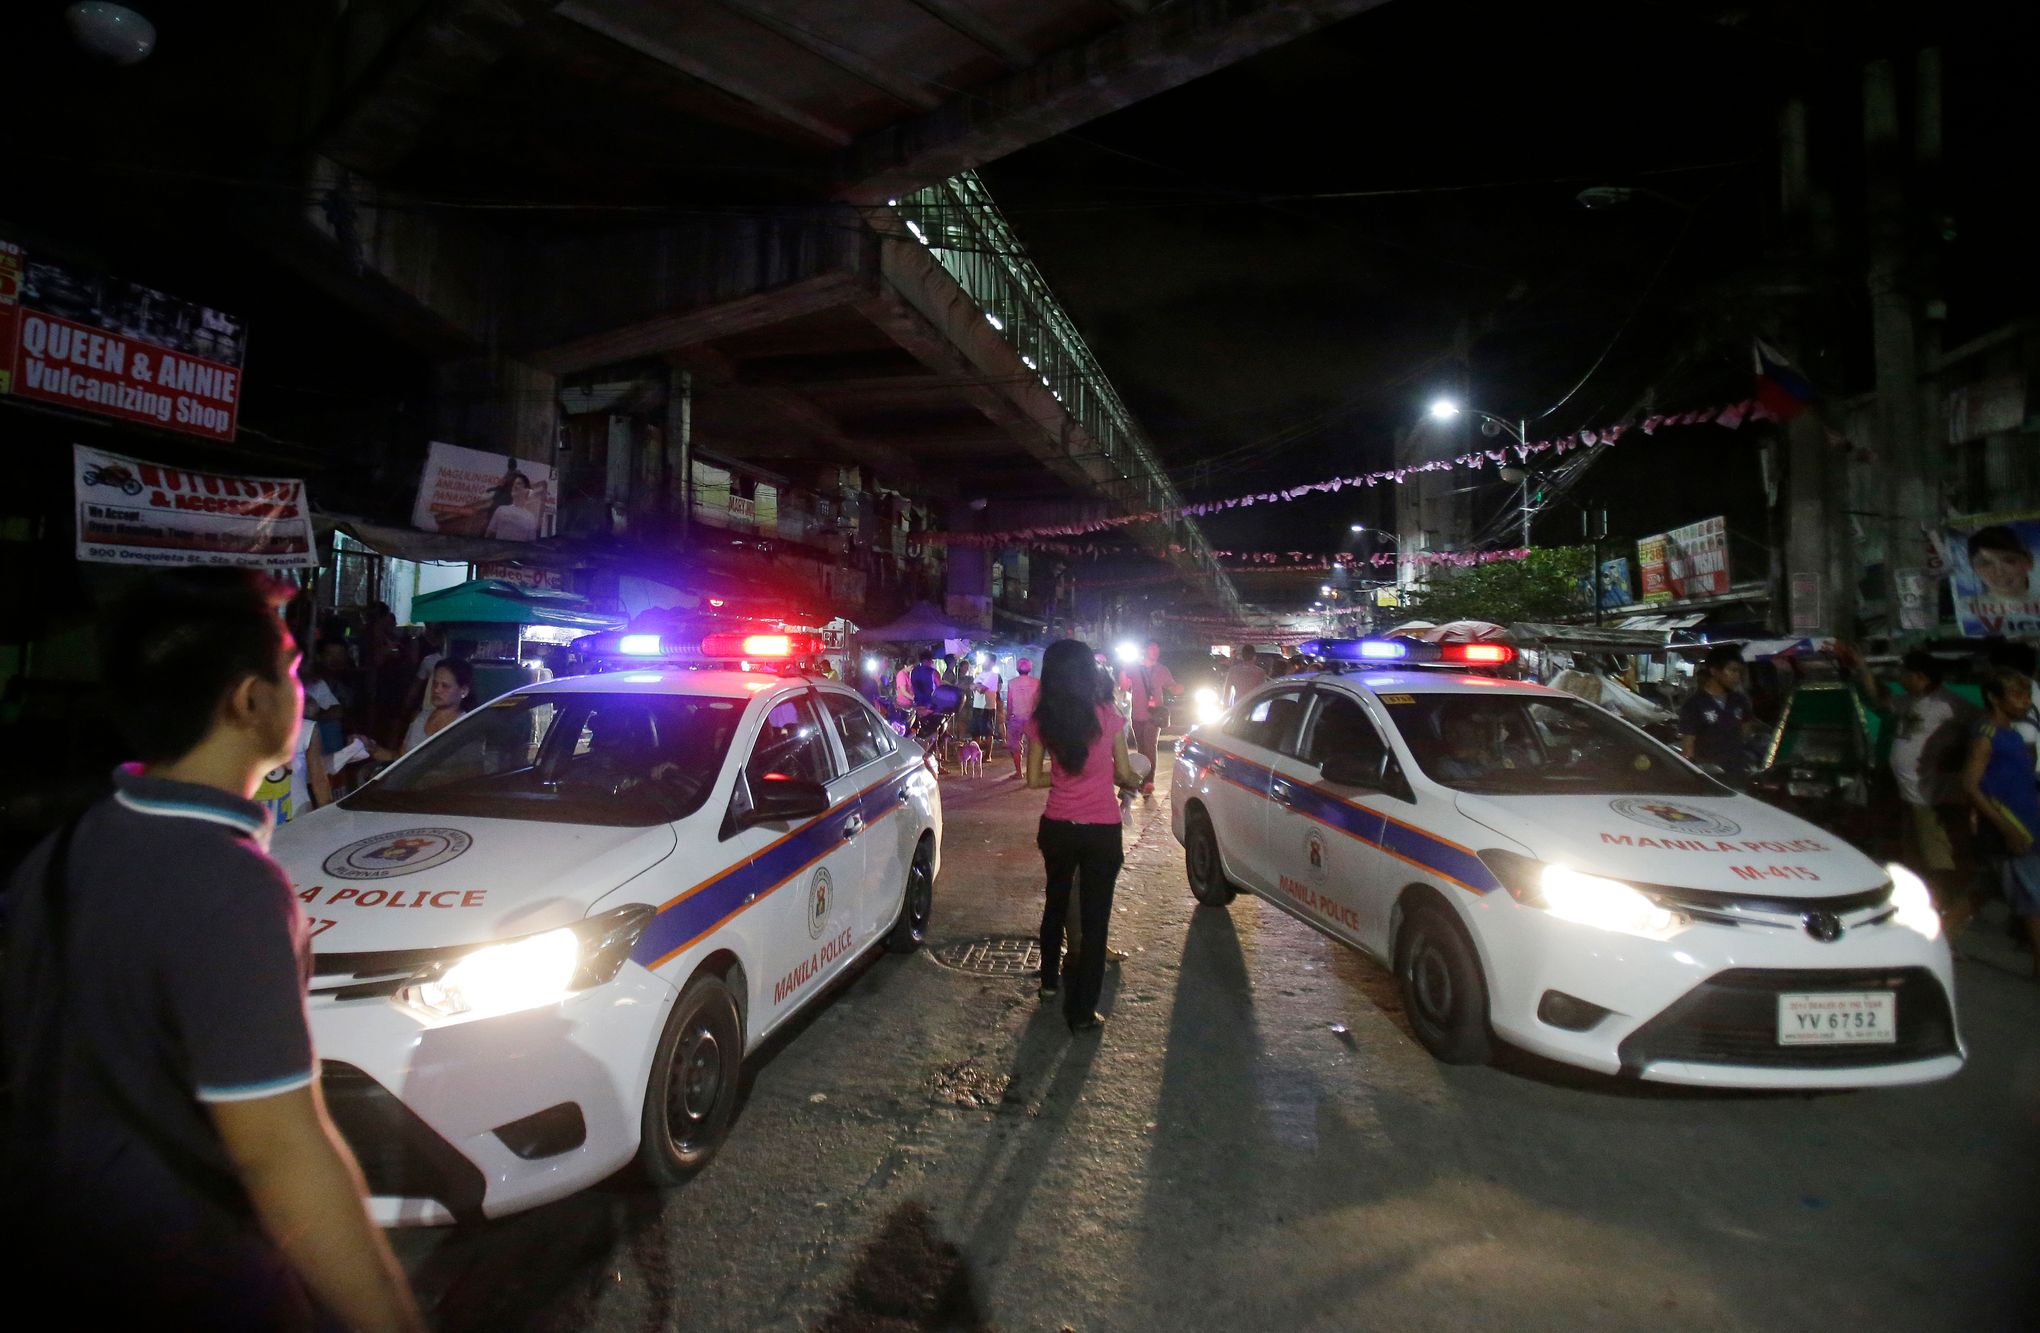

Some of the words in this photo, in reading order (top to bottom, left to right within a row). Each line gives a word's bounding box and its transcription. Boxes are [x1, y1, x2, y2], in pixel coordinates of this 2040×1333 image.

[22, 316, 127, 375] QUEEN
[131, 352, 153, 383] &
[156, 354, 237, 404] ANNIE
[25, 357, 173, 423] Vulcanizing
[175, 395, 231, 434] Shop
[88, 547, 116, 558] 900
[266, 556, 308, 565] Manila
[1599, 831, 1743, 853] MANILA
[325, 886, 488, 909] POLICE
[1279, 873, 1317, 909] MANILA
[1319, 895, 1360, 932] POLICE
[773, 953, 819, 1006] MANILA
[820, 926, 853, 969] POLICE
[1796, 1012, 1821, 1030] YV
[1828, 1011, 1877, 1030] 6752
